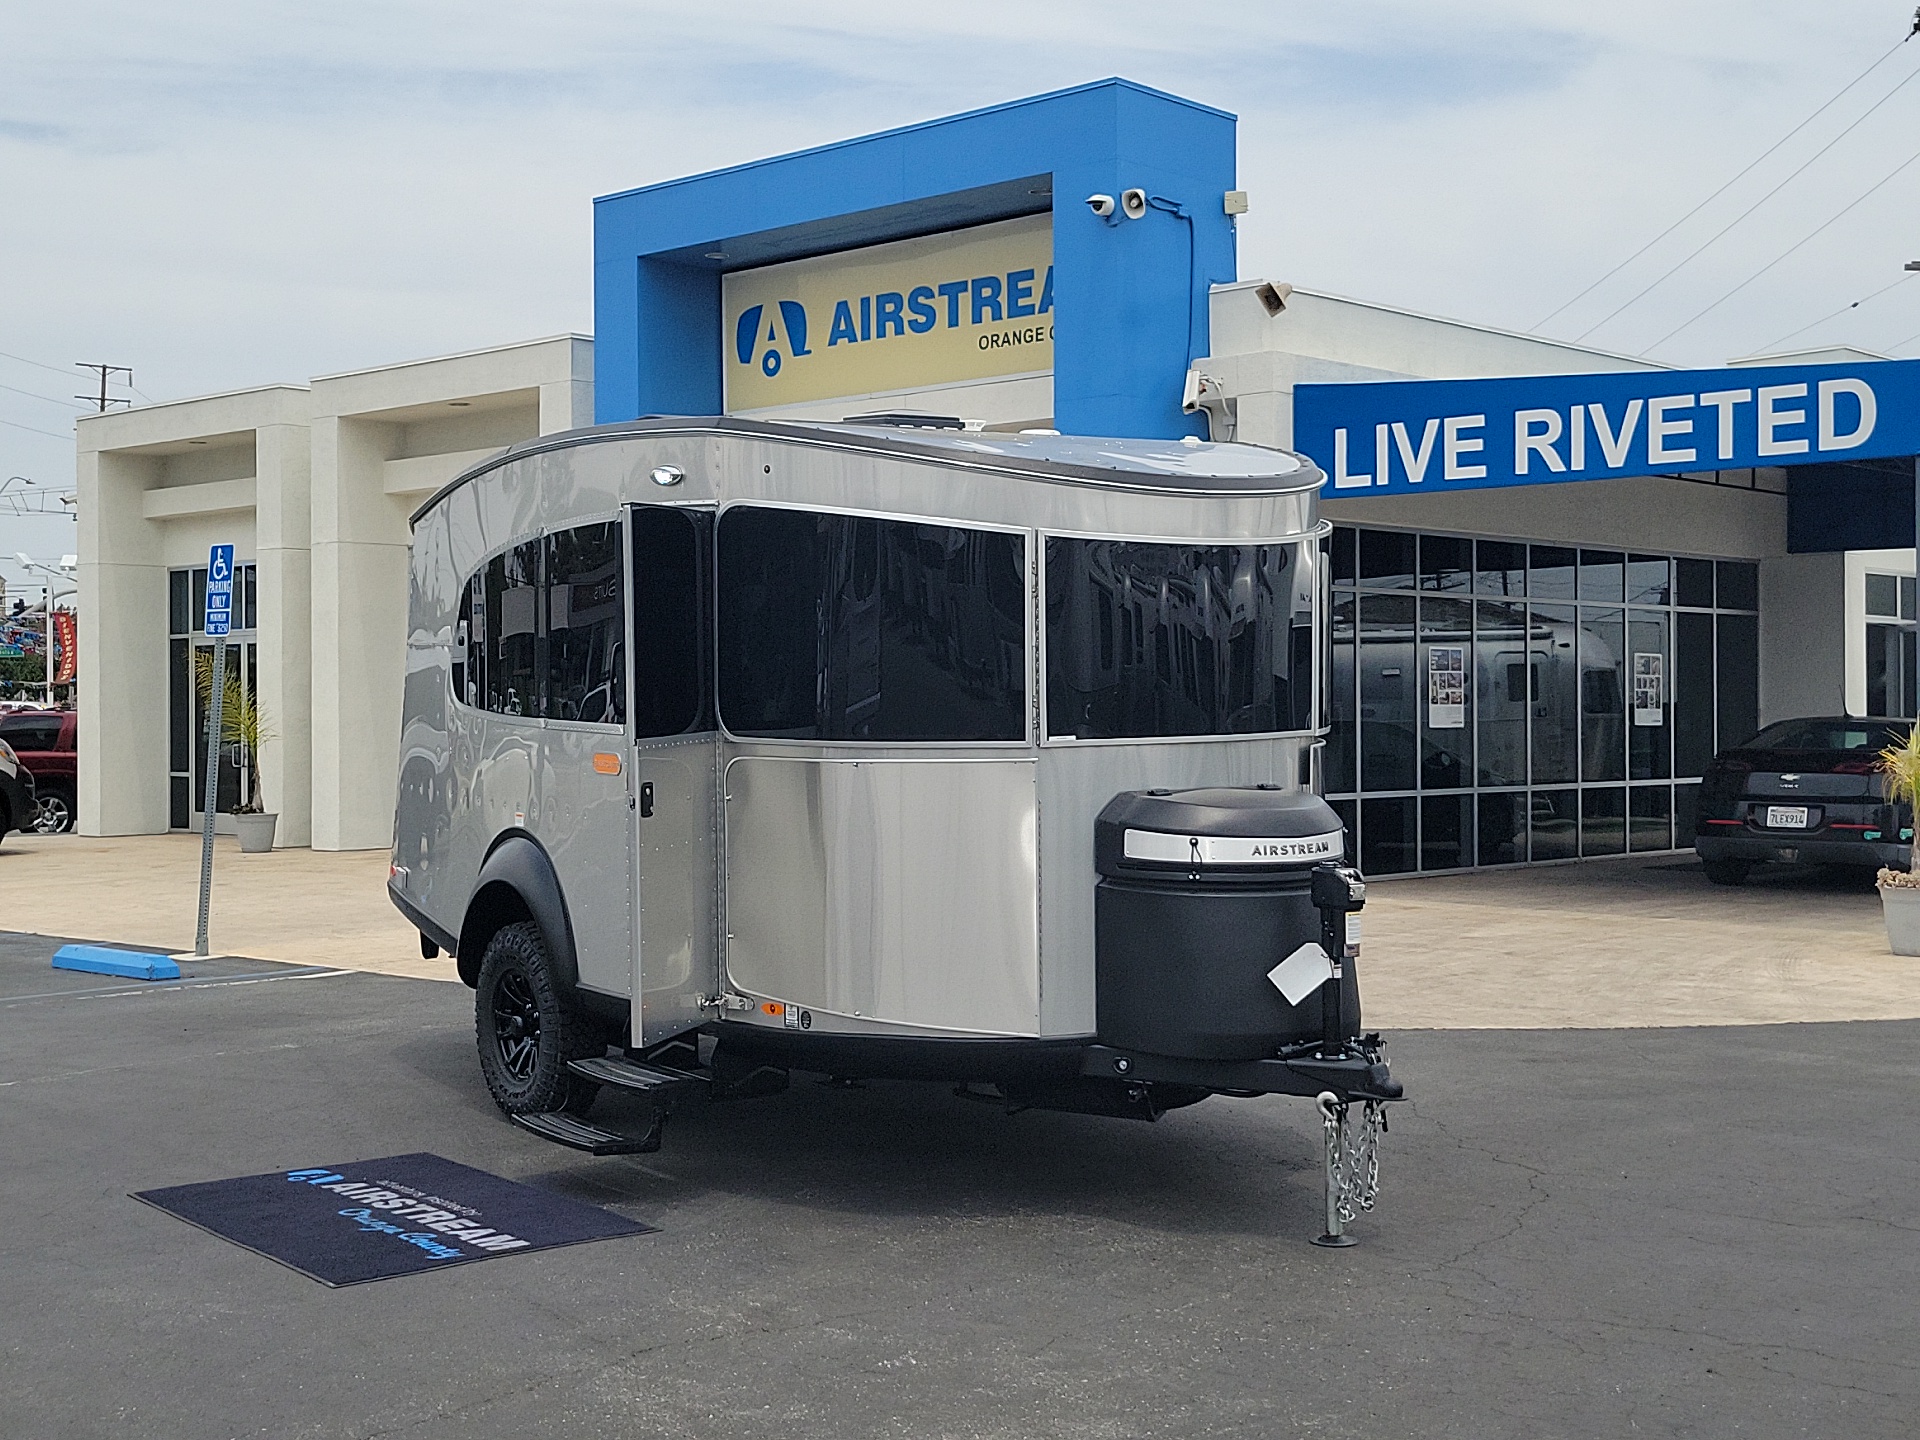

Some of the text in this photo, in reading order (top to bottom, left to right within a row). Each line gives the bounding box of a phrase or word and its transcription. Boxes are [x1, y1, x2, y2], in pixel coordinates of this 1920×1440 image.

[978, 326, 1045, 350] ORANGE
[1334, 378, 1878, 489] LIVE RIVETED
[208, 580, 230, 593] PARKING
[211, 595, 226, 608] ONLY
[1251, 841, 1329, 857] AIRSTREAM
[320, 1182, 531, 1252] AIRSTREAM
[337, 1208, 466, 1260] Orange County
